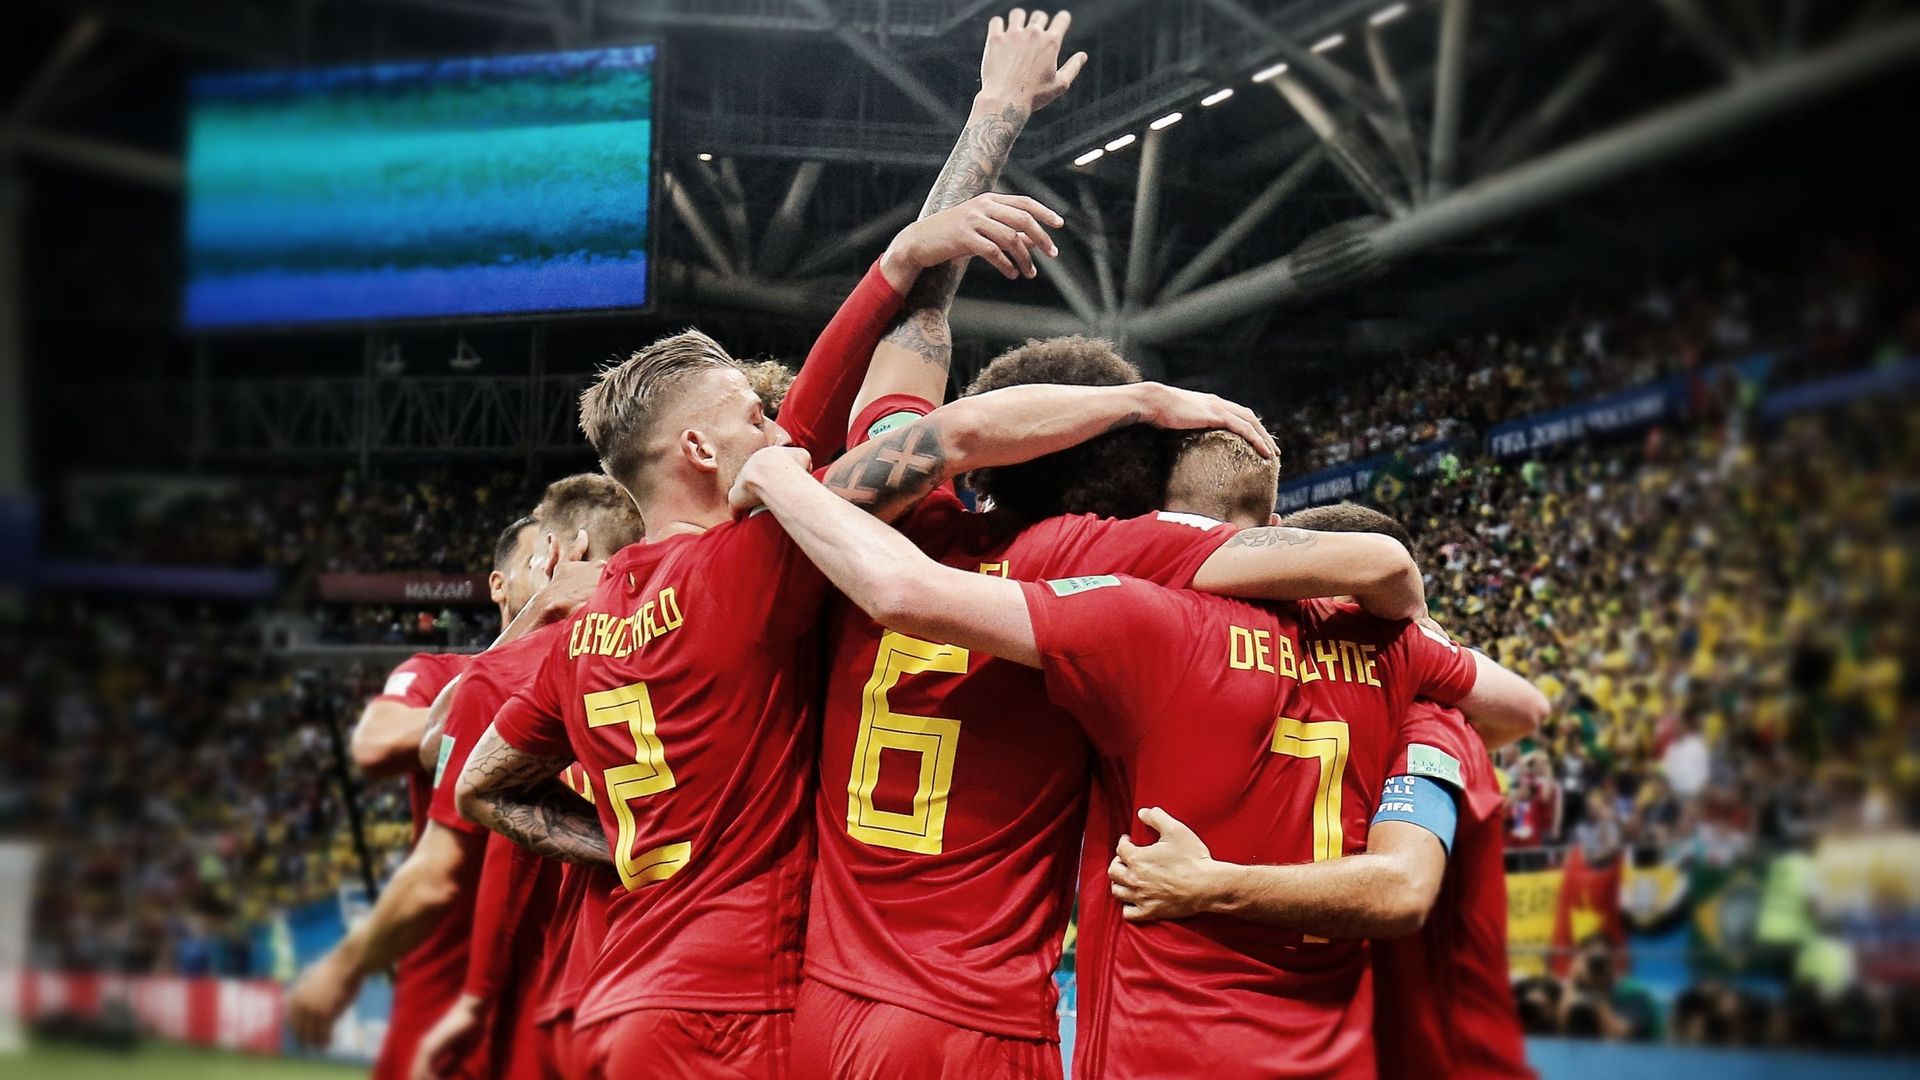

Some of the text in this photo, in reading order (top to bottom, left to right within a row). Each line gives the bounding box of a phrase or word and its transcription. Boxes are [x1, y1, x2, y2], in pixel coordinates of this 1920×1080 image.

[1229, 624, 1276, 674] DE
[584, 681, 692, 893] 2
[847, 628, 970, 855] 6
[1270, 716, 1350, 863] 7
[1378, 802, 1414, 813] FIFA
